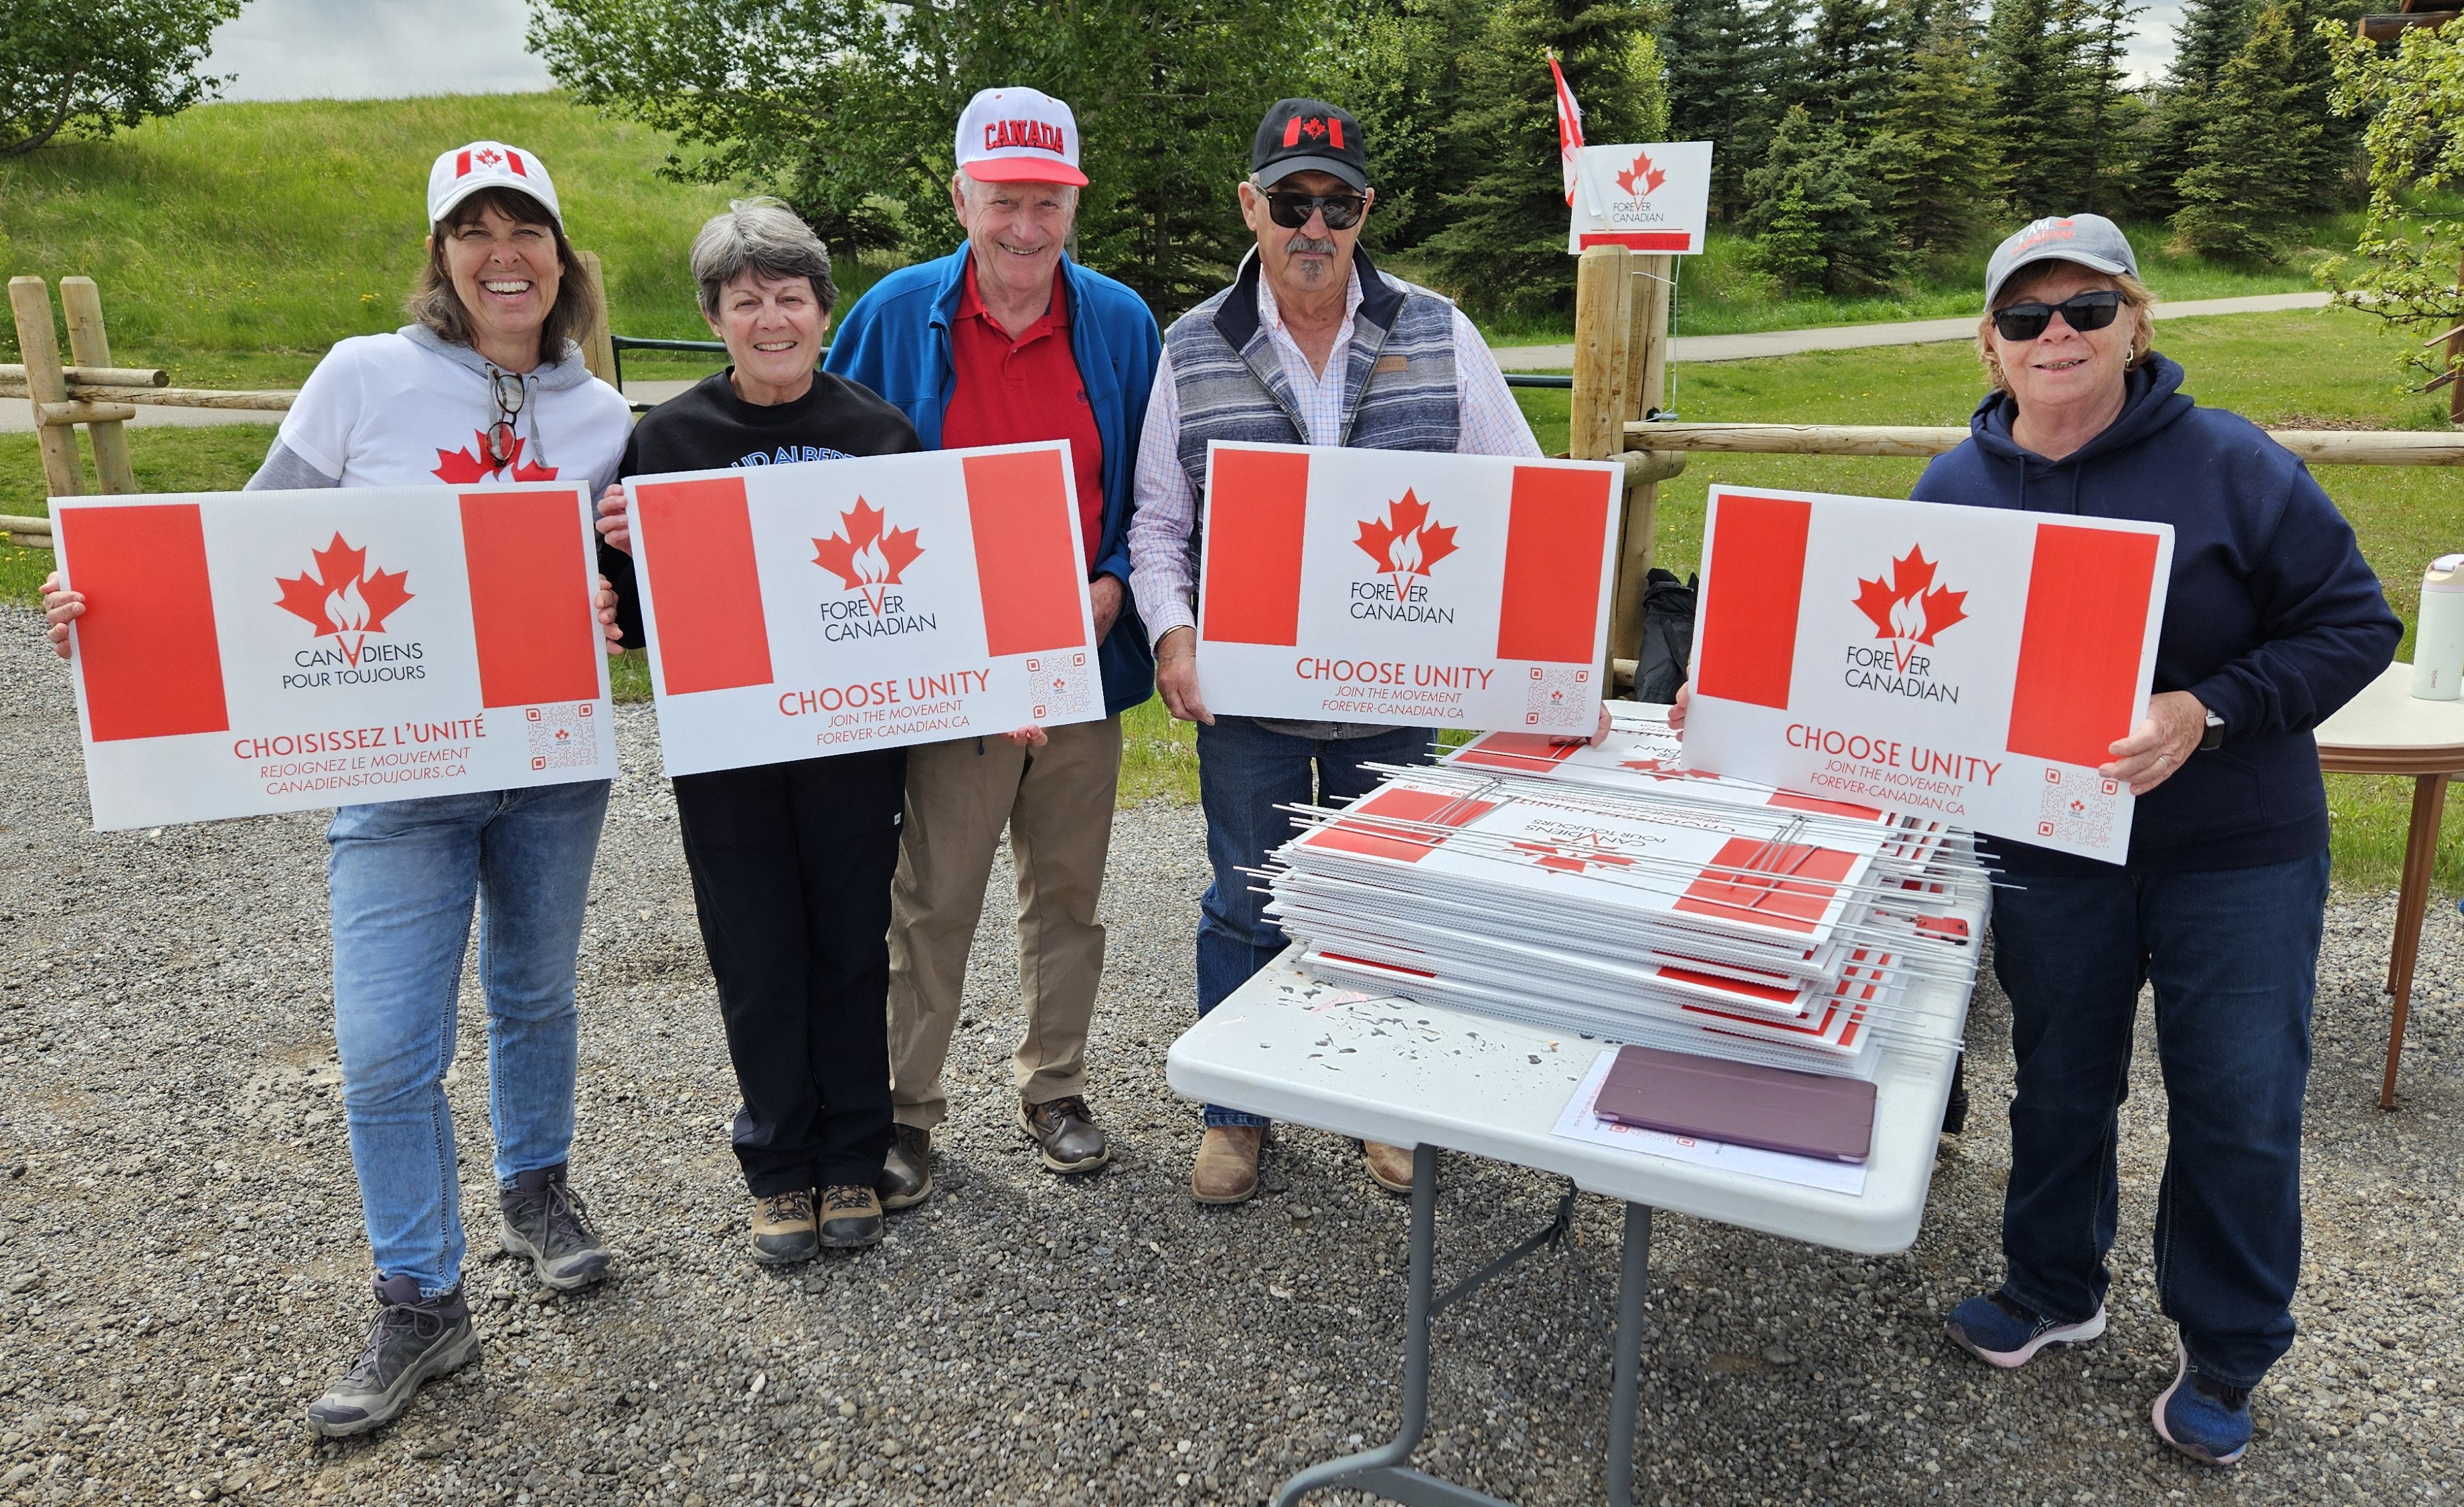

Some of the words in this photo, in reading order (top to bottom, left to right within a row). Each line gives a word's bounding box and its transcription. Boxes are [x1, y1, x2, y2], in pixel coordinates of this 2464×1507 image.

[985, 120, 1064, 156] CANADA
[1613, 197, 1651, 213] FOREVER
[1613, 213, 1664, 222] CANADIAN
[1625, 238, 1662, 247] Petition
[1666, 238, 1690, 247] Here
[821, 586, 905, 621] FOREVER
[1351, 574, 1428, 604] FOREVER
[825, 613, 936, 642] CANADIAN
[1350, 602, 1454, 624] CANADIAN
[1296, 657, 1406, 685] CHOOSE
[1414, 664, 1495, 690] UNITY
[1847, 640, 1931, 677] FOREVER
[282, 672, 331, 689] POUR
[335, 665, 426, 685] TOUJOURS
[1845, 669, 1959, 705] CANADIAN
[778, 680, 901, 716] CHOOSE
[908, 669, 991, 701] UNITY
[1335, 685, 1365, 698] JOIN
[1368, 688, 1389, 699] THE
[1391, 689, 1463, 703] MOVEMENT
[828, 713, 859, 728] JOIN
[863, 709, 886, 723] THE
[889, 699, 963, 719] MOVEMENT
[1321, 700, 1464, 719] FOREVER-CANADIAN.CA
[234, 727, 387, 759] CHOISISSEZ
[817, 715, 970, 745] FOREVER-CANADIAN.CA
[260, 758, 347, 778] REJOIGNEZ
[351, 757, 366, 770] LE
[370, 746, 471, 768] MOUVEMENT
[1786, 723, 1902, 768] CHOOSE
[1910, 746, 2003, 786] UNITY
[266, 764, 467, 795] CANADIENS-TOUJOURS.CA
[1825, 759, 1858, 775] JOIN
[1860, 765, 1883, 781] THE
[1884, 772, 1964, 798] MOVEMENT
[1810, 772, 1965, 816] FOREVER-CANADIAN.CA
[1534, 818, 1616, 836] TOUJOURS
[1623, 832, 1667, 844] POUR
